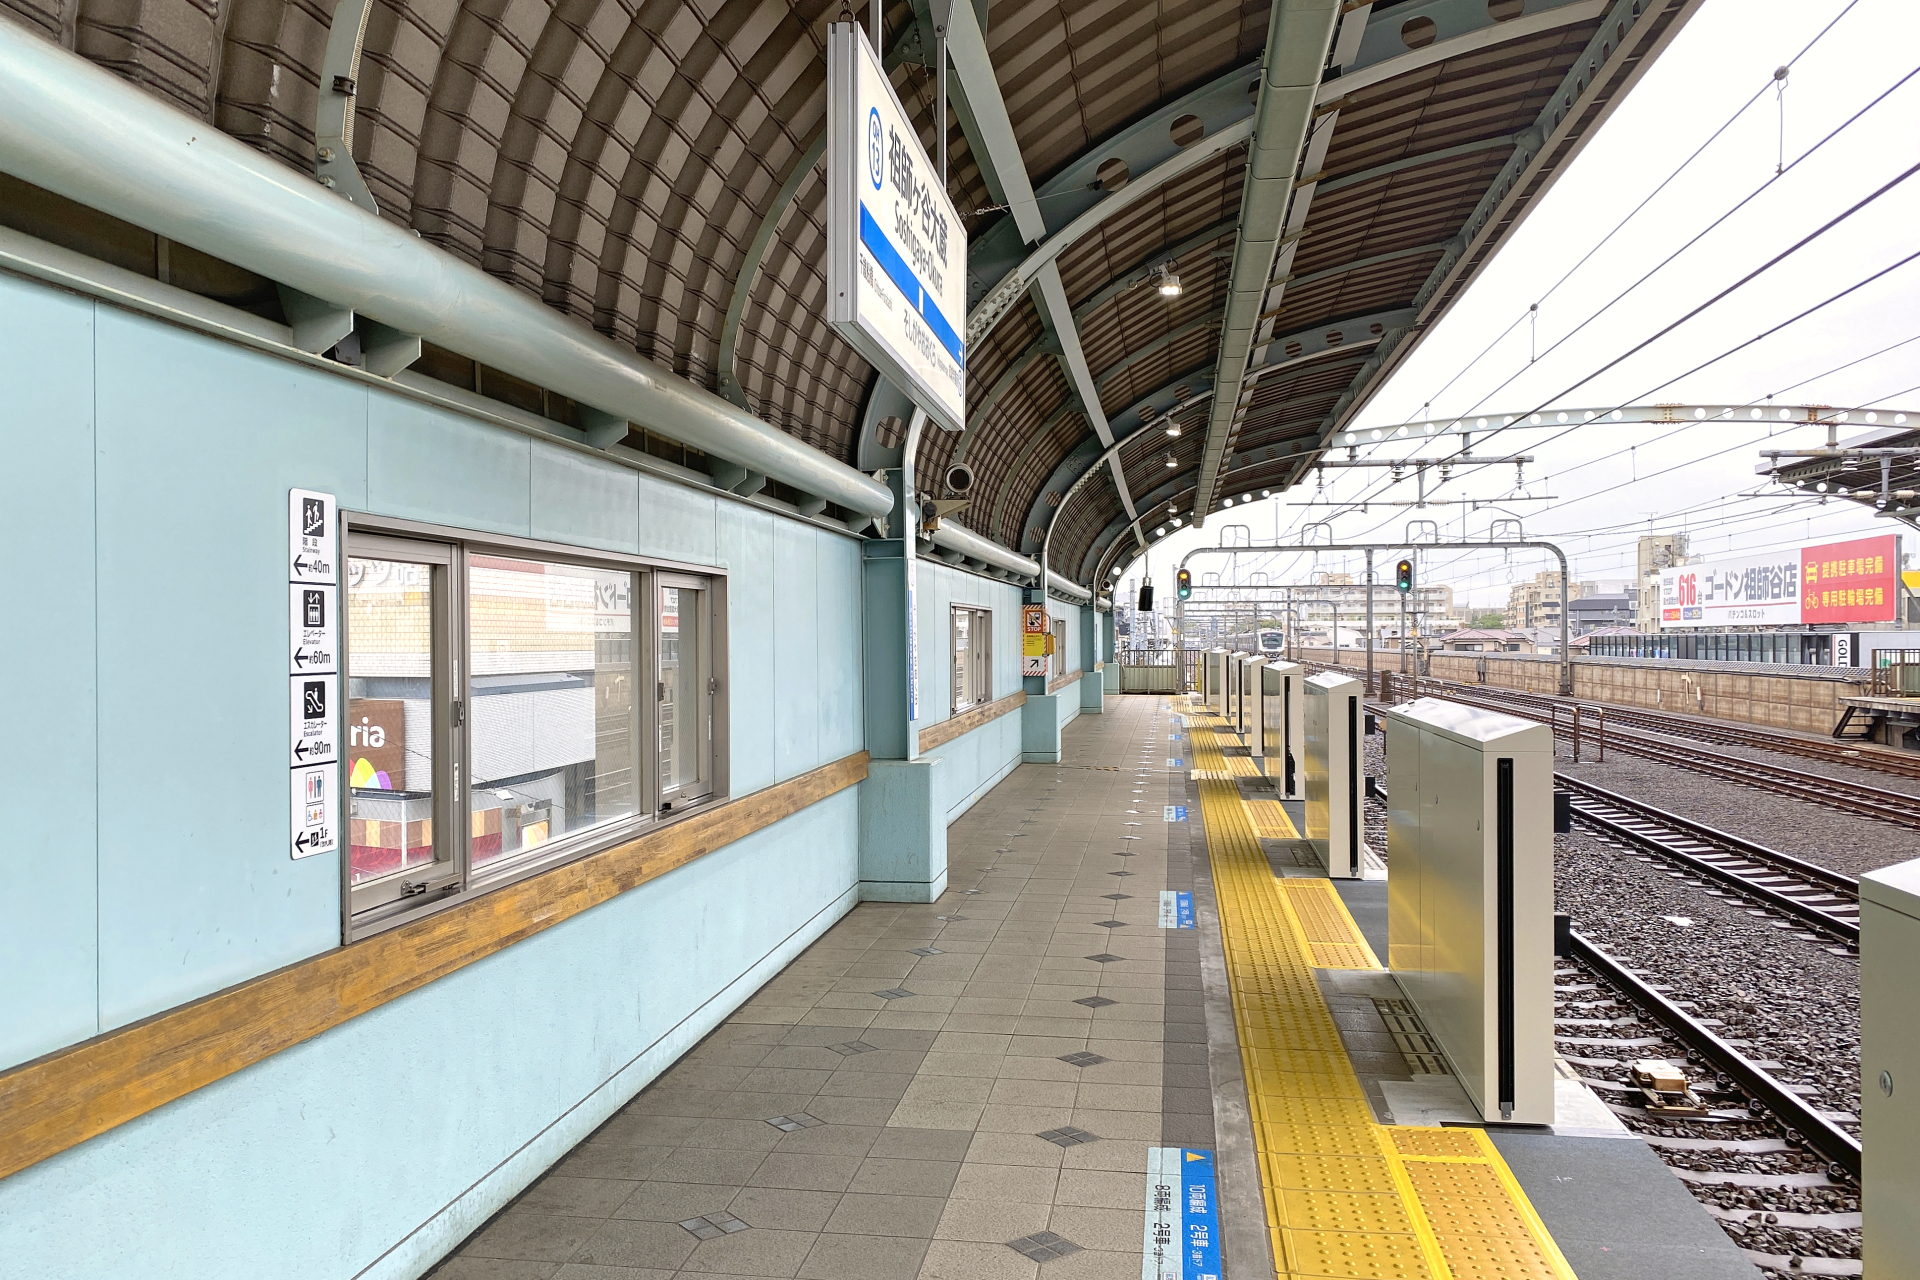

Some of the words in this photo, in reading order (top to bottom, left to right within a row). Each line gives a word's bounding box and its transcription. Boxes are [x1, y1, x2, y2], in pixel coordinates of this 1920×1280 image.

[873, 121, 880, 145] OH
[872, 142, 880, 177] 13
[894, 200, 943, 297] Soshigaya-Okura
[1705, 562, 1797, 601] ゴードン祖師谷店
[303, 729, 323, 738] Escalator
[320, 826, 328, 839] 1F
[1154, 1184, 1171, 1212] 8両編成
[1189, 1184, 1207, 1214] 10両編成
